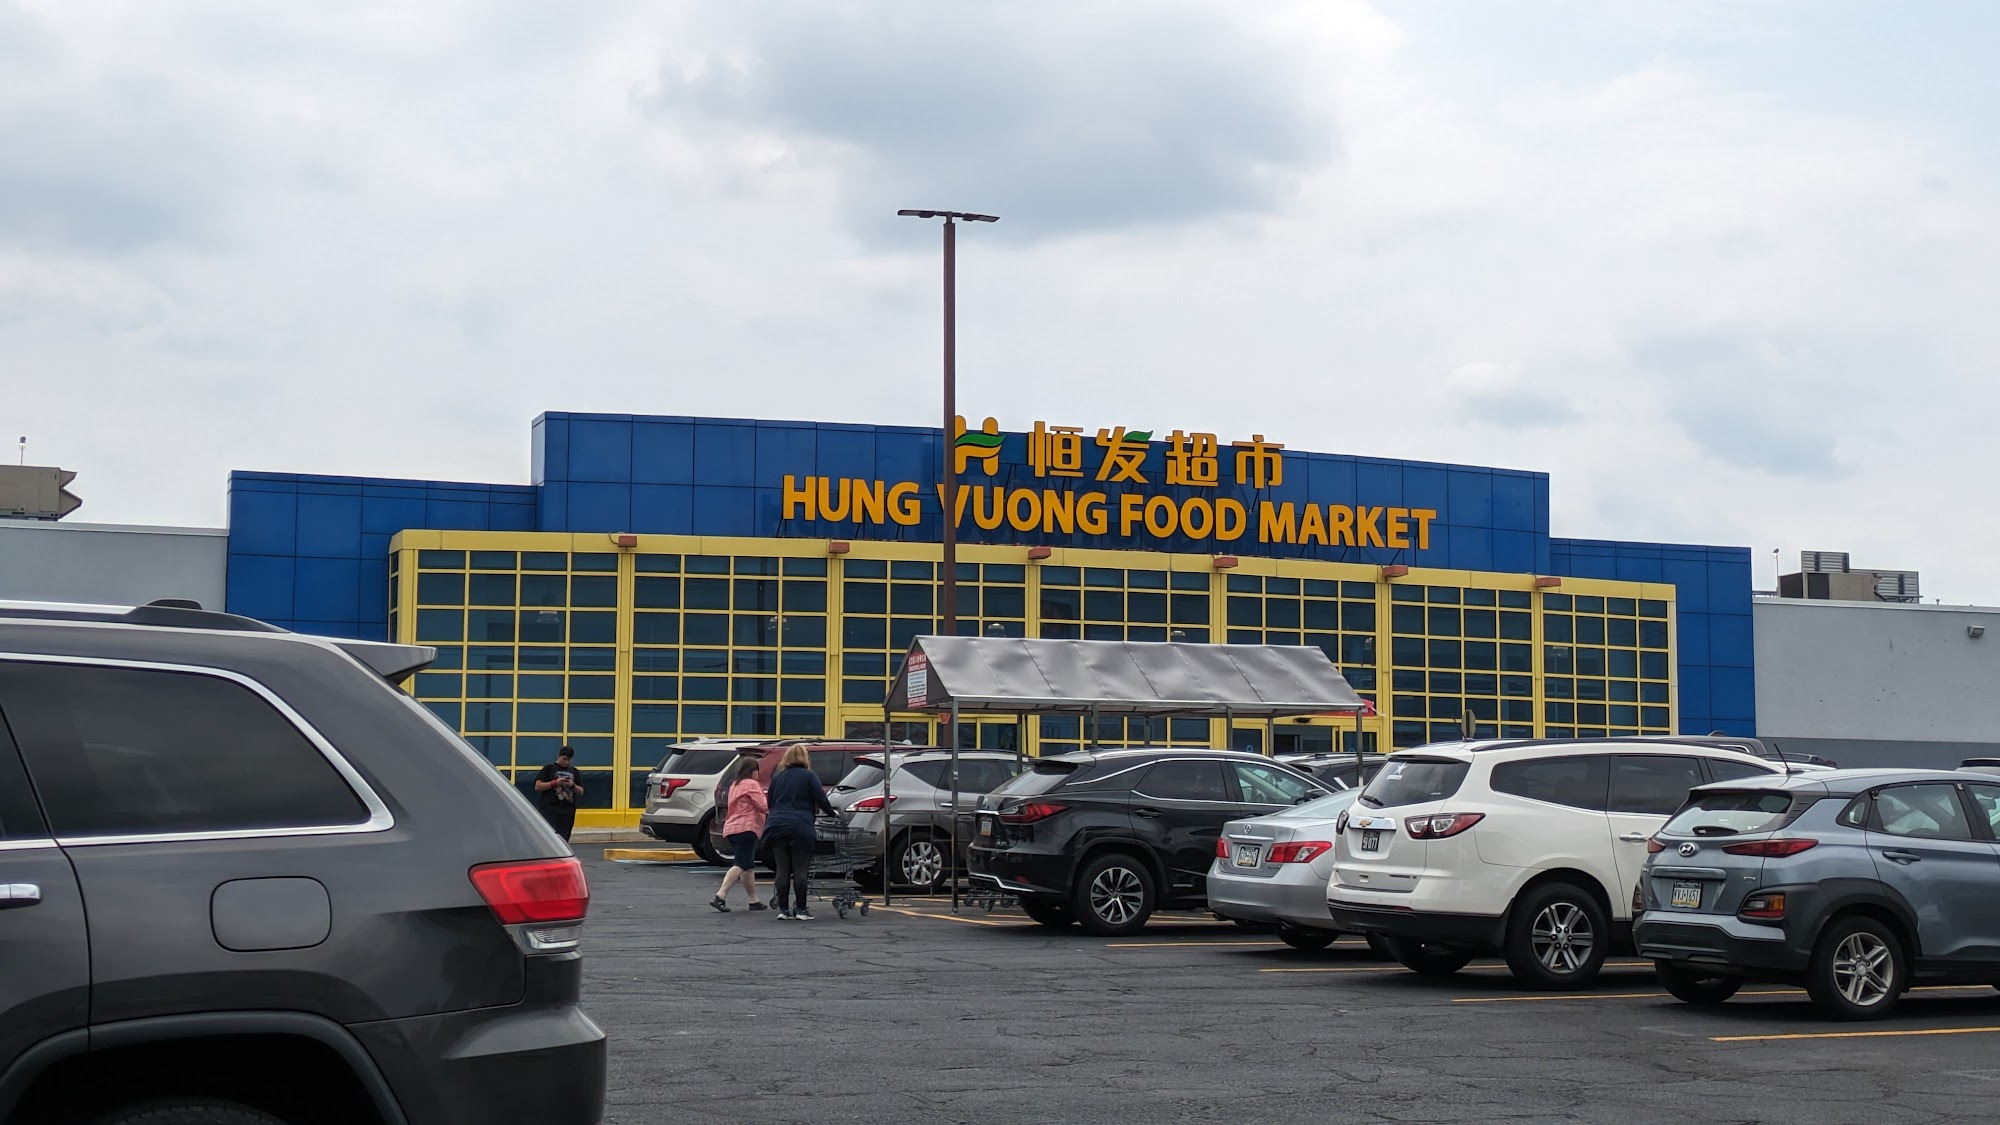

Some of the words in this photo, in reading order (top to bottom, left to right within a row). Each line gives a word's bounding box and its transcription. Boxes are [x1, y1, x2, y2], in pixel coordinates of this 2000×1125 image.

[1028, 420, 1285, 489] 恒发超市
[783, 474, 921, 526] HUNG
[936, 482, 1108, 535] VUONG
[1120, 493, 1247, 541] FOOD
[1258, 500, 1437, 550] MARKET
